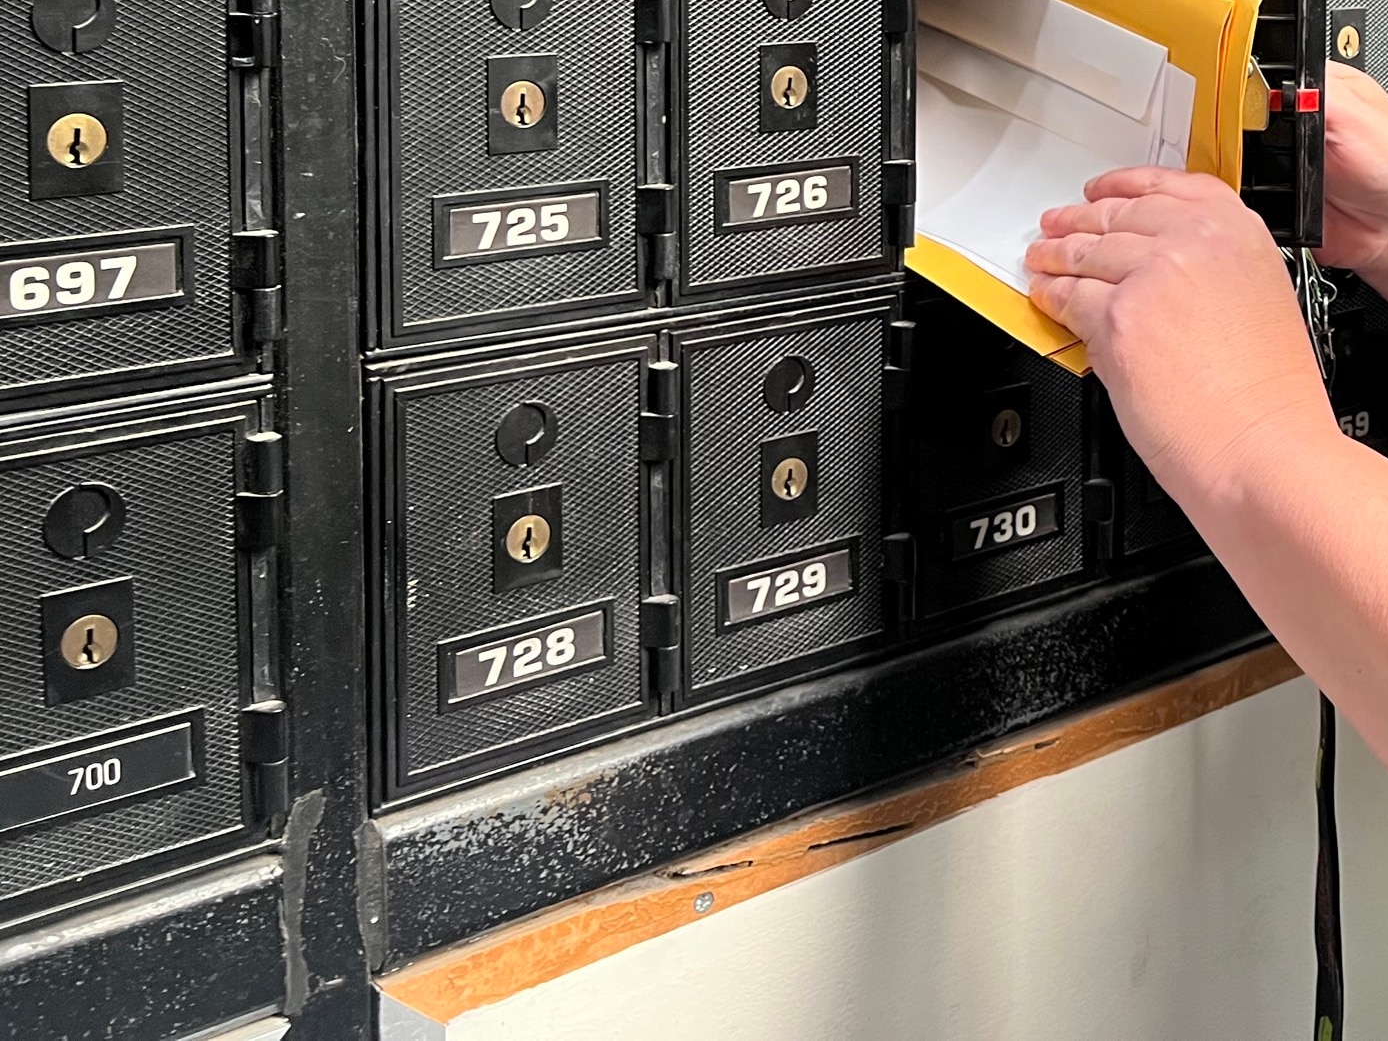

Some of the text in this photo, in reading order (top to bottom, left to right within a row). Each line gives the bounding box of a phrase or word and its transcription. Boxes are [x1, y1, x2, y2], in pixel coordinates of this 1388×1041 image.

[747, 175, 828, 218] 726
[472, 203, 569, 250] 725
[9, 255, 137, 311] 697
[971, 505, 1036, 548] 730
[747, 562, 826, 614] 729
[478, 627, 575, 687] 728
[68, 759, 120, 795] 700
